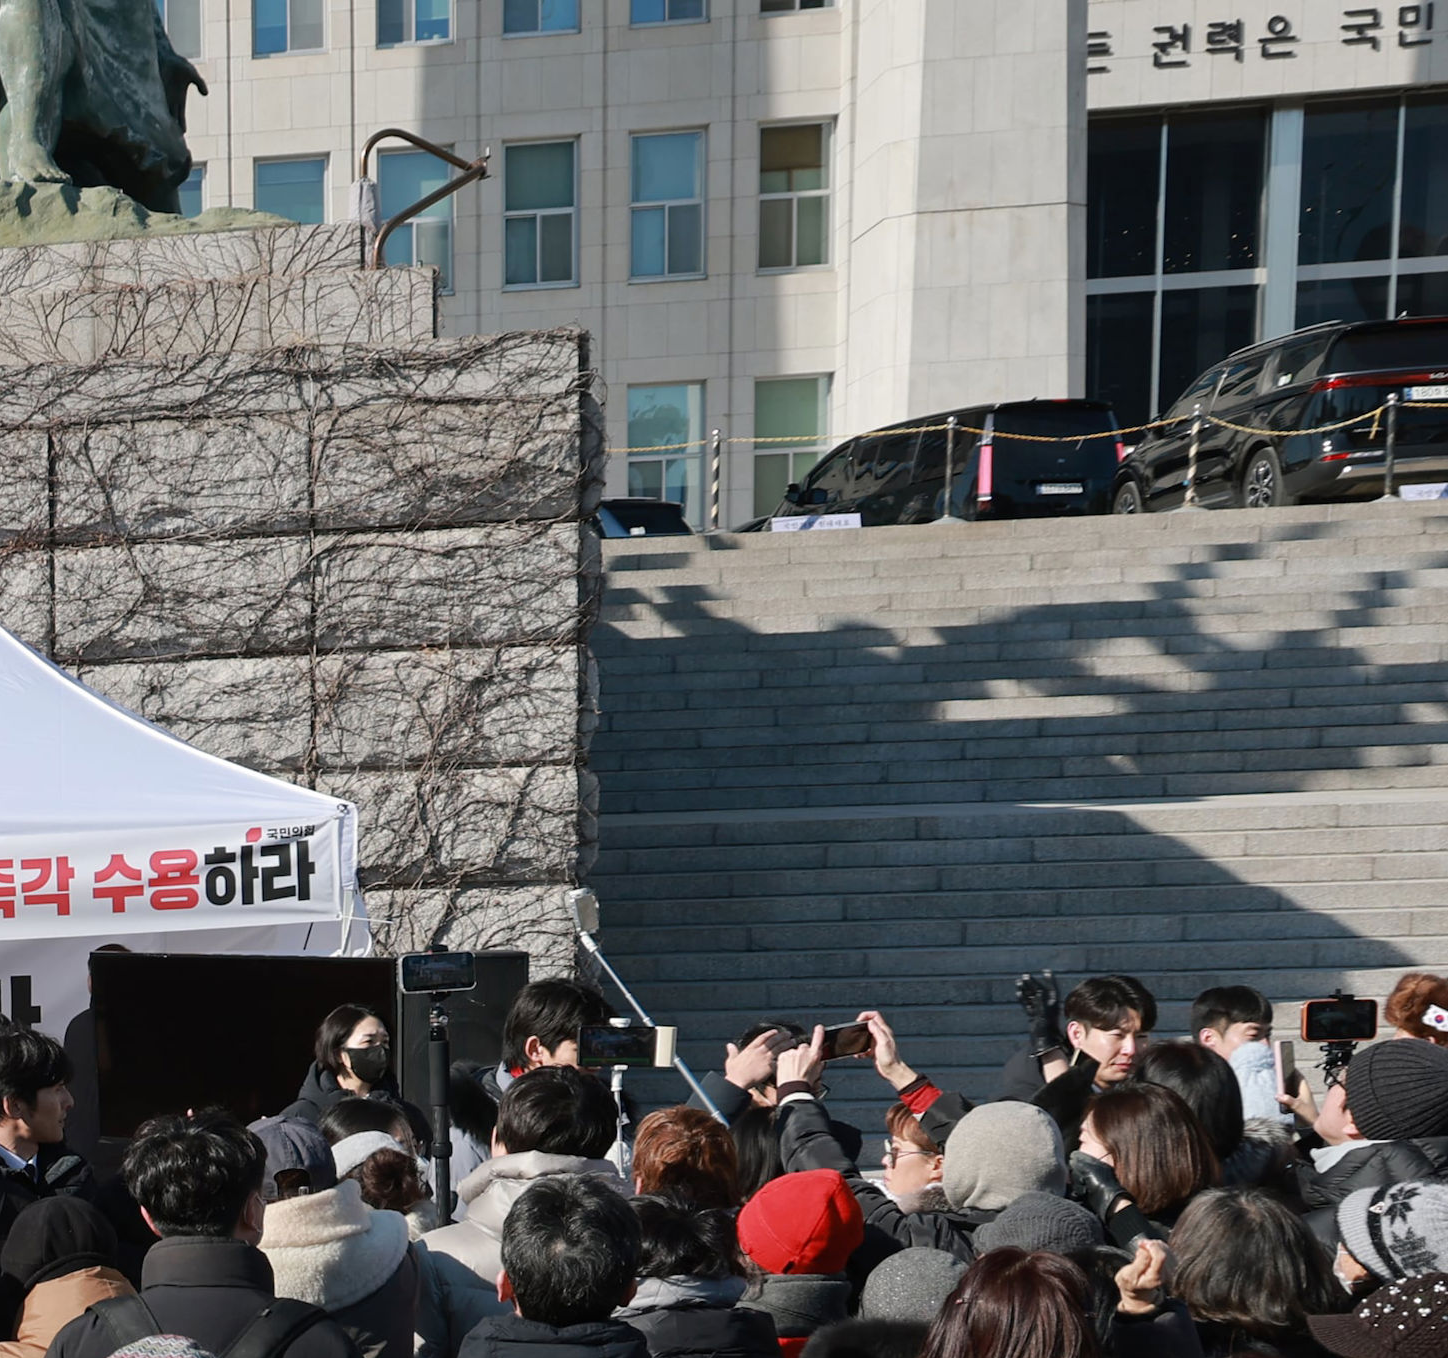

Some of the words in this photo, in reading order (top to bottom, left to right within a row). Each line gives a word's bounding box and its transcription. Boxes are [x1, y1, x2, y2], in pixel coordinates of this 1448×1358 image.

[1152, 14, 1297, 69] 권력은
[1340, 1, 1436, 51] 국민
[92, 840, 317, 914] 수용하라
